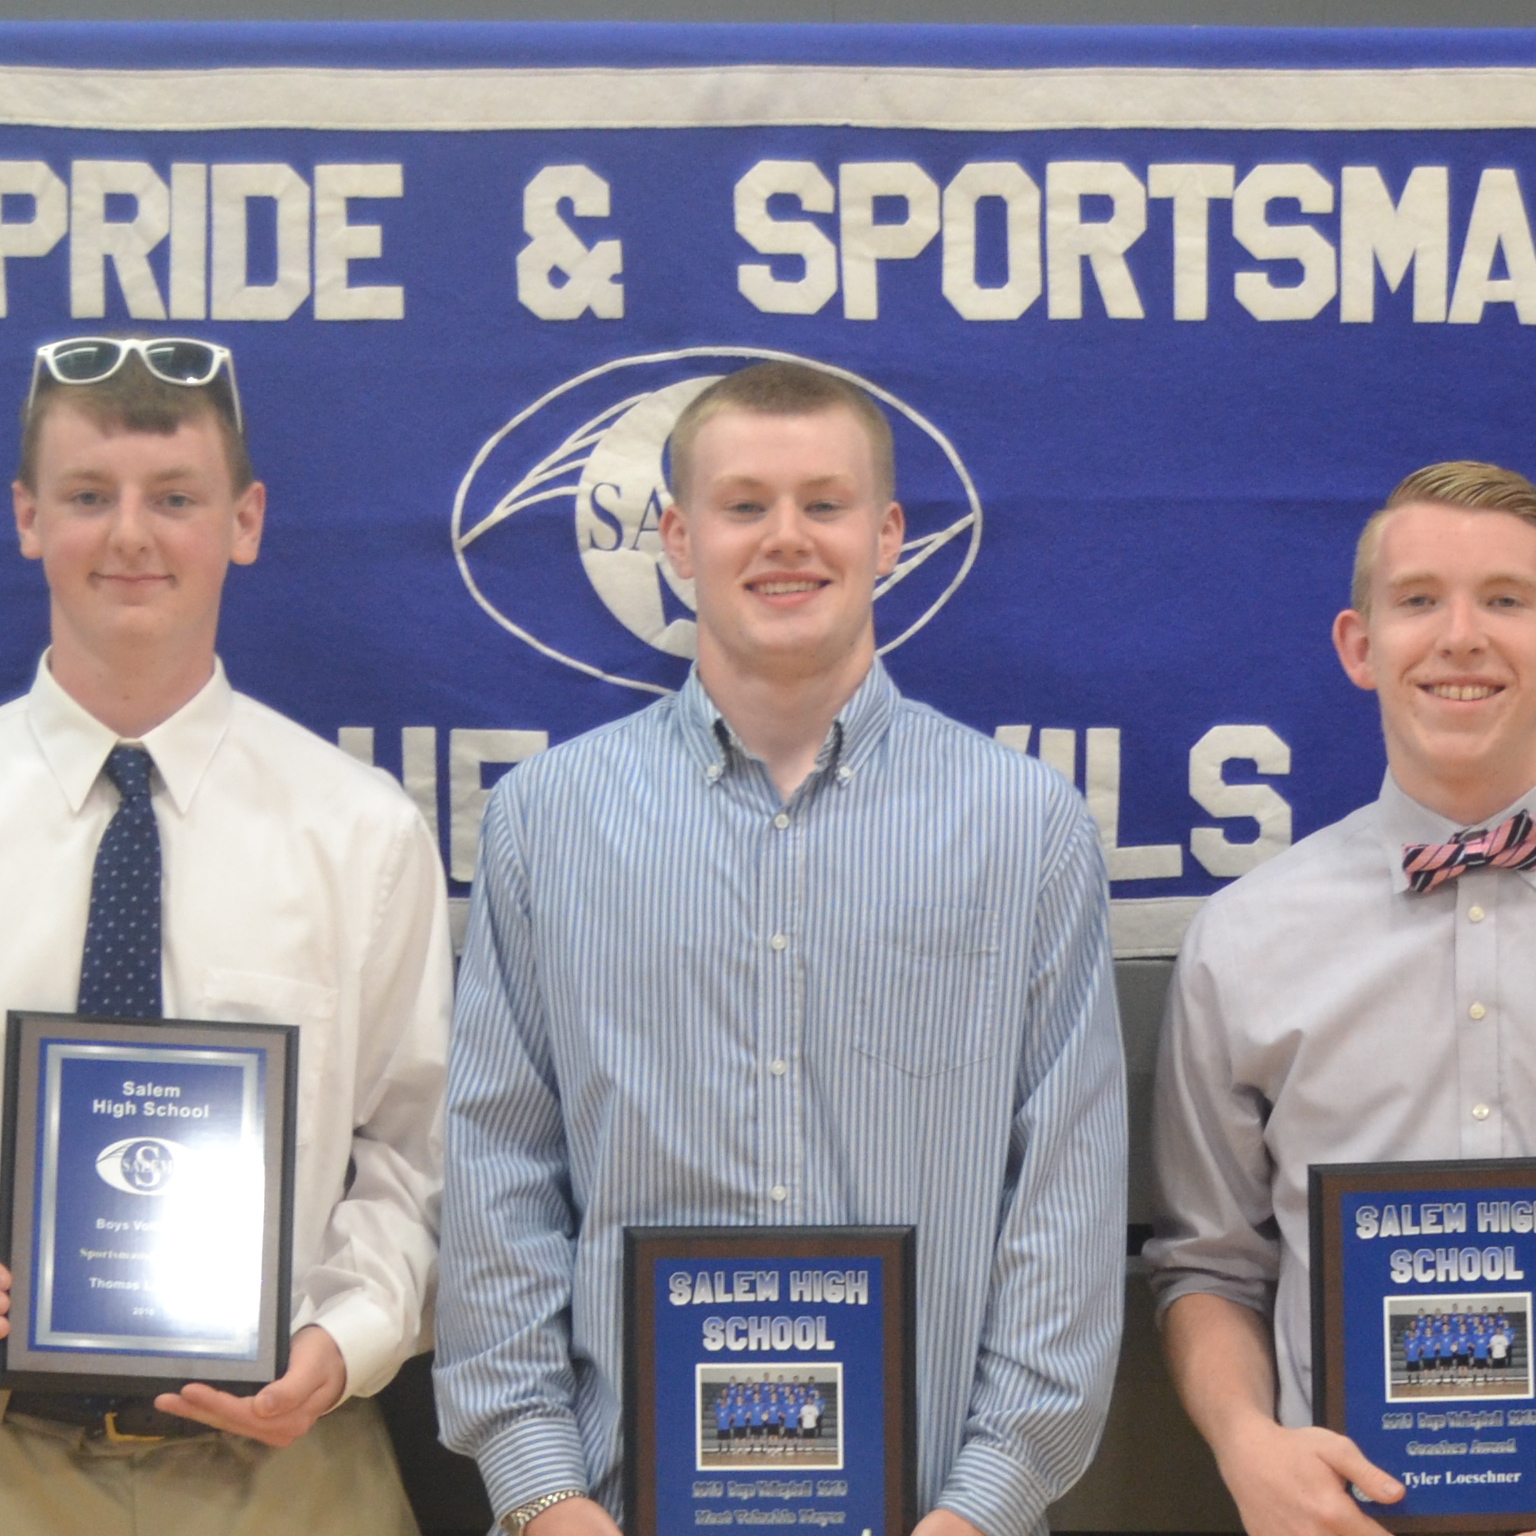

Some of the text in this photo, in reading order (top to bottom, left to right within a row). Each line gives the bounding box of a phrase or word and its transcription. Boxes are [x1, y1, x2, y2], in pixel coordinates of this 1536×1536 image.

[516, 164, 625, 322] &
[122, 1080, 181, 1099] Salem
[92, 1099, 210, 1119] High School
[96, 1218, 130, 1232] Boys
[1355, 1202, 1467, 1240] SALEM
[1390, 1246, 1525, 1284] SCHOOL
[89, 1276, 140, 1291] Thomas
[669, 1270, 869, 1306] SALEM HIGH
[702, 1315, 836, 1352] SCHOOL
[1402, 1469, 1522, 1489] Tyler Loeschner
